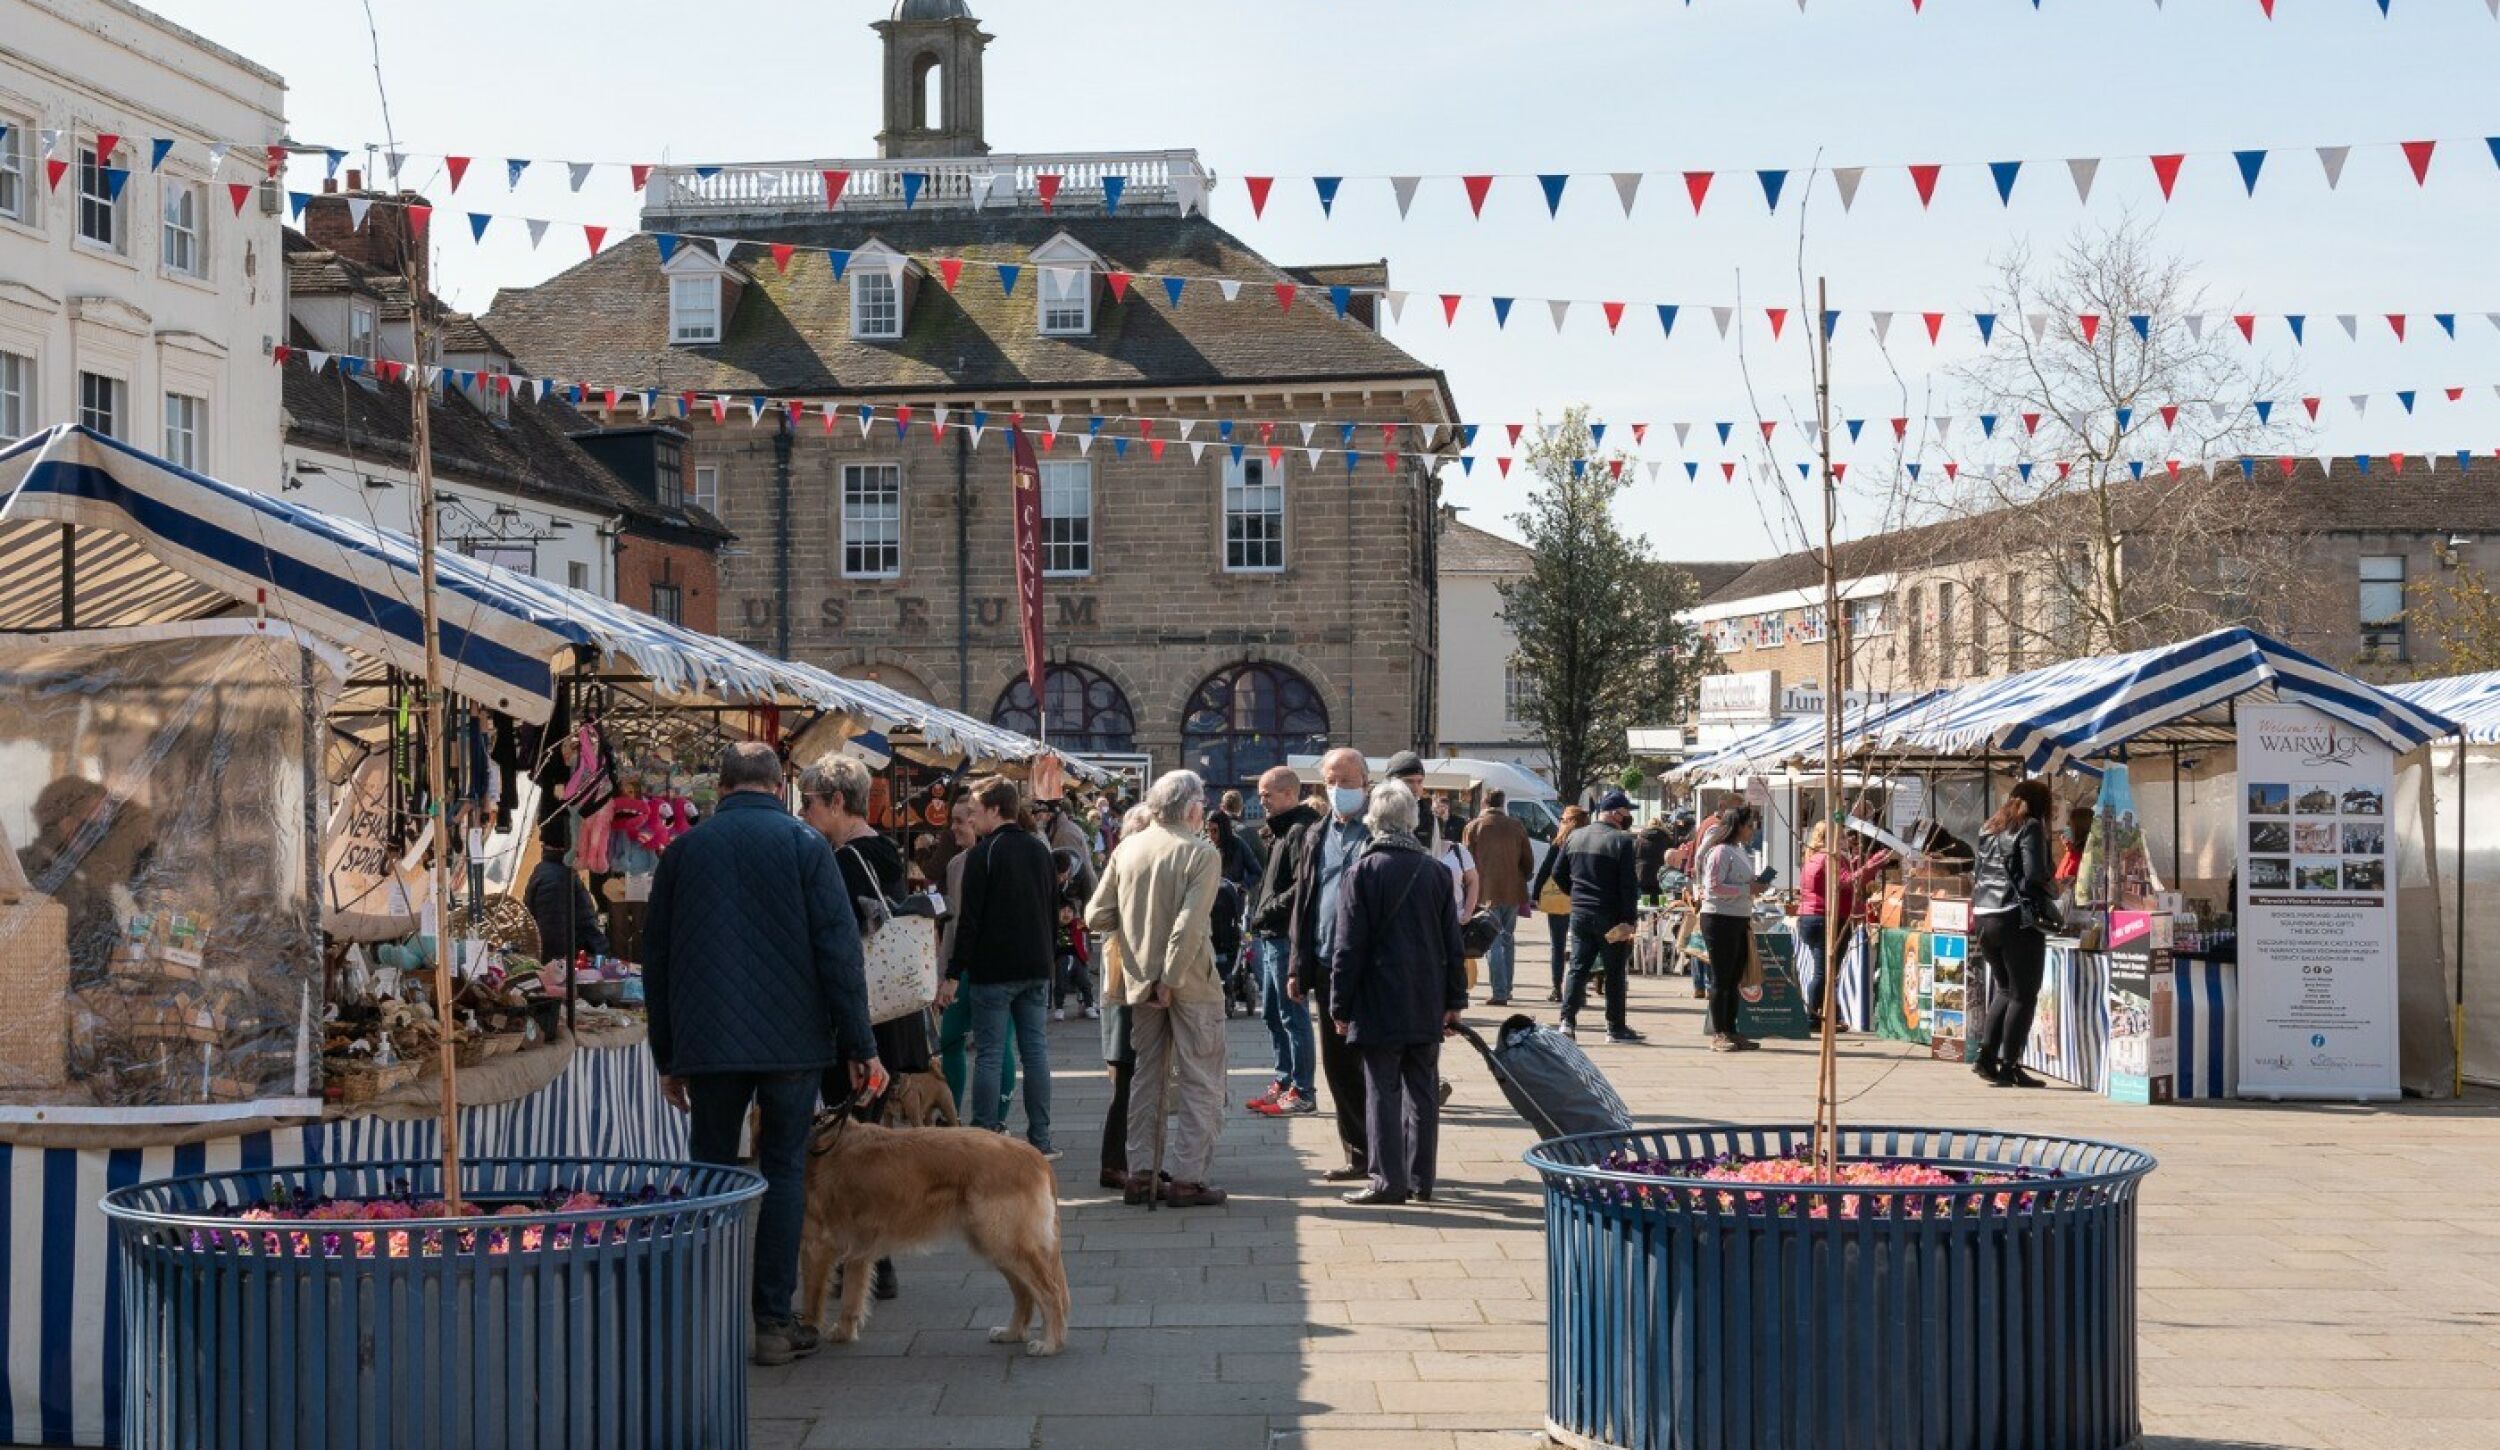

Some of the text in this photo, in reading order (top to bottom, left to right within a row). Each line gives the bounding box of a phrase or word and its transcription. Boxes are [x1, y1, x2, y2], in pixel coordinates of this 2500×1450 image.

[742, 597, 1098, 630] USEUM
[1783, 690, 1858, 710] Jumo
[2260, 720, 2323, 733] Welcome to
[2260, 725, 2367, 757] WARWICK
